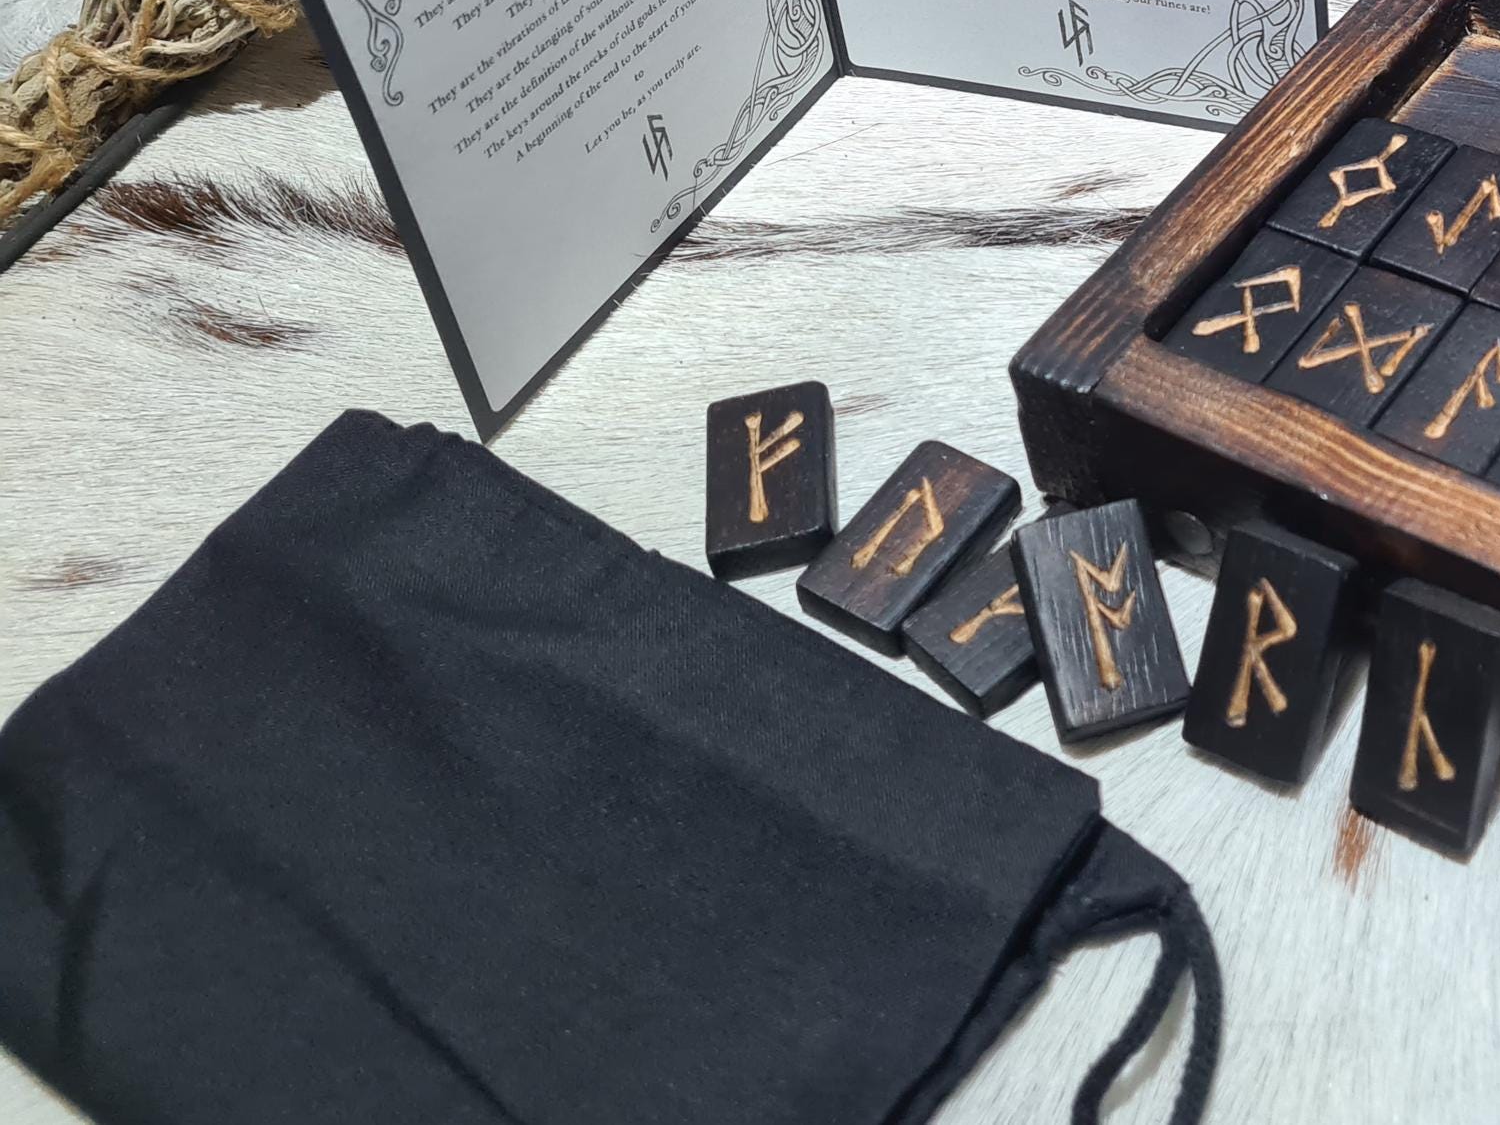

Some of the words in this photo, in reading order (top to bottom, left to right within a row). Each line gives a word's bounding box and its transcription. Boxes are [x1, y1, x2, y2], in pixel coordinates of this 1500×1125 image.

[452, 3, 482, 31] They
[1189, 2, 1212, 15] are!
[633, 69, 645, 82] to
[584, 134, 603, 154] Let
[603, 117, 622, 140] you
[620, 106, 637, 120] be,
[637, 94, 647, 107] as
[646, 78, 664, 100] you
[664, 56, 686, 81] truly
[686, 44, 702, 61] are.
